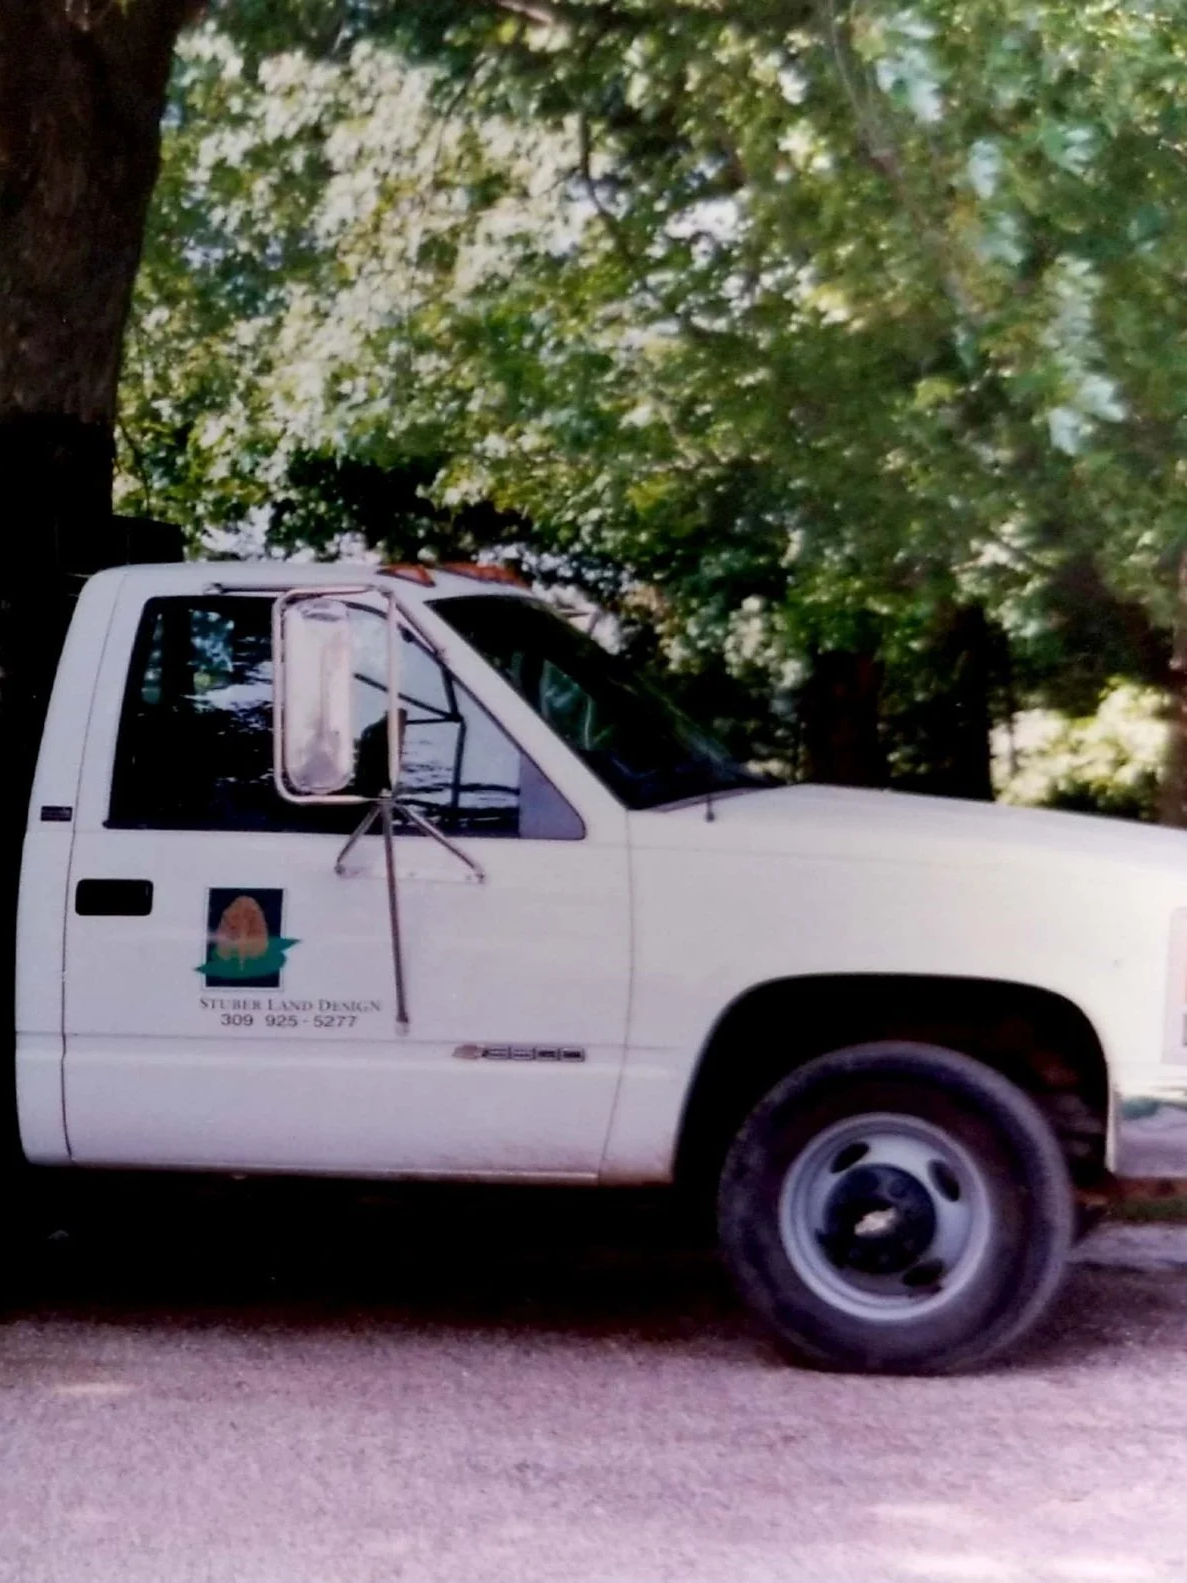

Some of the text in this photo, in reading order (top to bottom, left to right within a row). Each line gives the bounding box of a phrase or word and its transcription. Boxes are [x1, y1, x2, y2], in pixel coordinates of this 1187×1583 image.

[199, 998, 381, 1013] STUBER LAND DESIGN
[220, 1013, 254, 1026] 309
